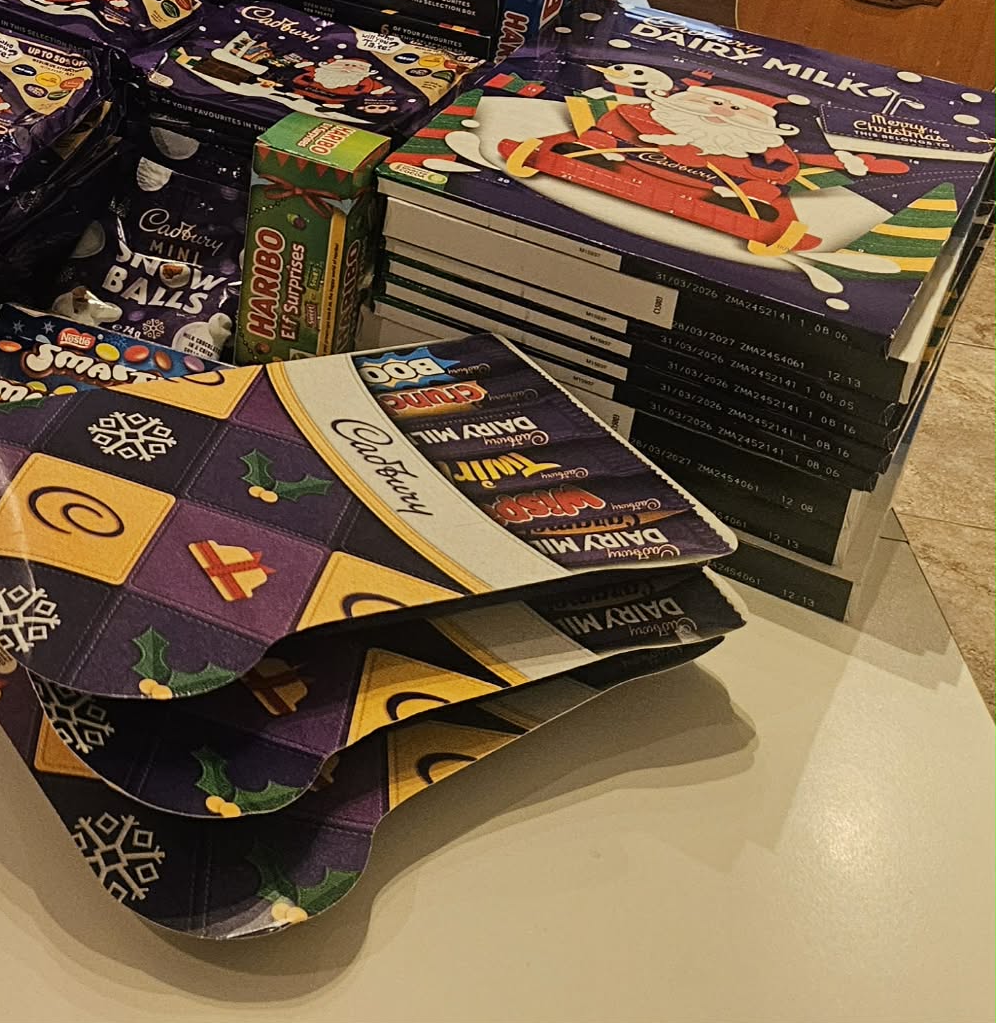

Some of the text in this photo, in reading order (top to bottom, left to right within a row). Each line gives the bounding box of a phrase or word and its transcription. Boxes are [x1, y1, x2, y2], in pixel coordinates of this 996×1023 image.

[242, 7, 320, 43] Cadbury
[28, 47, 40, 56] UP
[41, 50, 52, 59] TO
[630, 24, 870, 98] DAIRY MILK
[309, 126, 356, 155] HARIBO
[854, 120, 948, 142] Christmas
[854, 130, 878, 138] THIS
[881, 133, 932, 145] BELONGS
[872, 114, 927, 134] Merry
[638, 153, 717, 180] Cadbury
[139, 208, 224, 256] Cadbury
[149, 240, 202, 266] MINI
[102, 264, 208, 315] BALLS
[246, 227, 285, 340] HARIBO
[281, 243, 304, 340] Elf Surprises
[656, 271, 790, 321] 31/03/2026 ZMA2452141
[660, 334, 797, 389] 31/03/2026 ZMA2452141
[740, 342, 804, 369] ZMA2454061
[668, 361, 799, 413] 31/03/2026 ZMA2452141
[462, 416, 538, 441] DAIRY
[484, 430, 550, 448] Cadbury
[331, 418, 434, 516] Cadbury
[456, 452, 560, 489] Twir
[494, 488, 606, 524] Wisp
[583, 526, 670, 552] DAIRY
[607, 543, 680, 560] Cadbury
[604, 597, 685, 630] DAIRY
